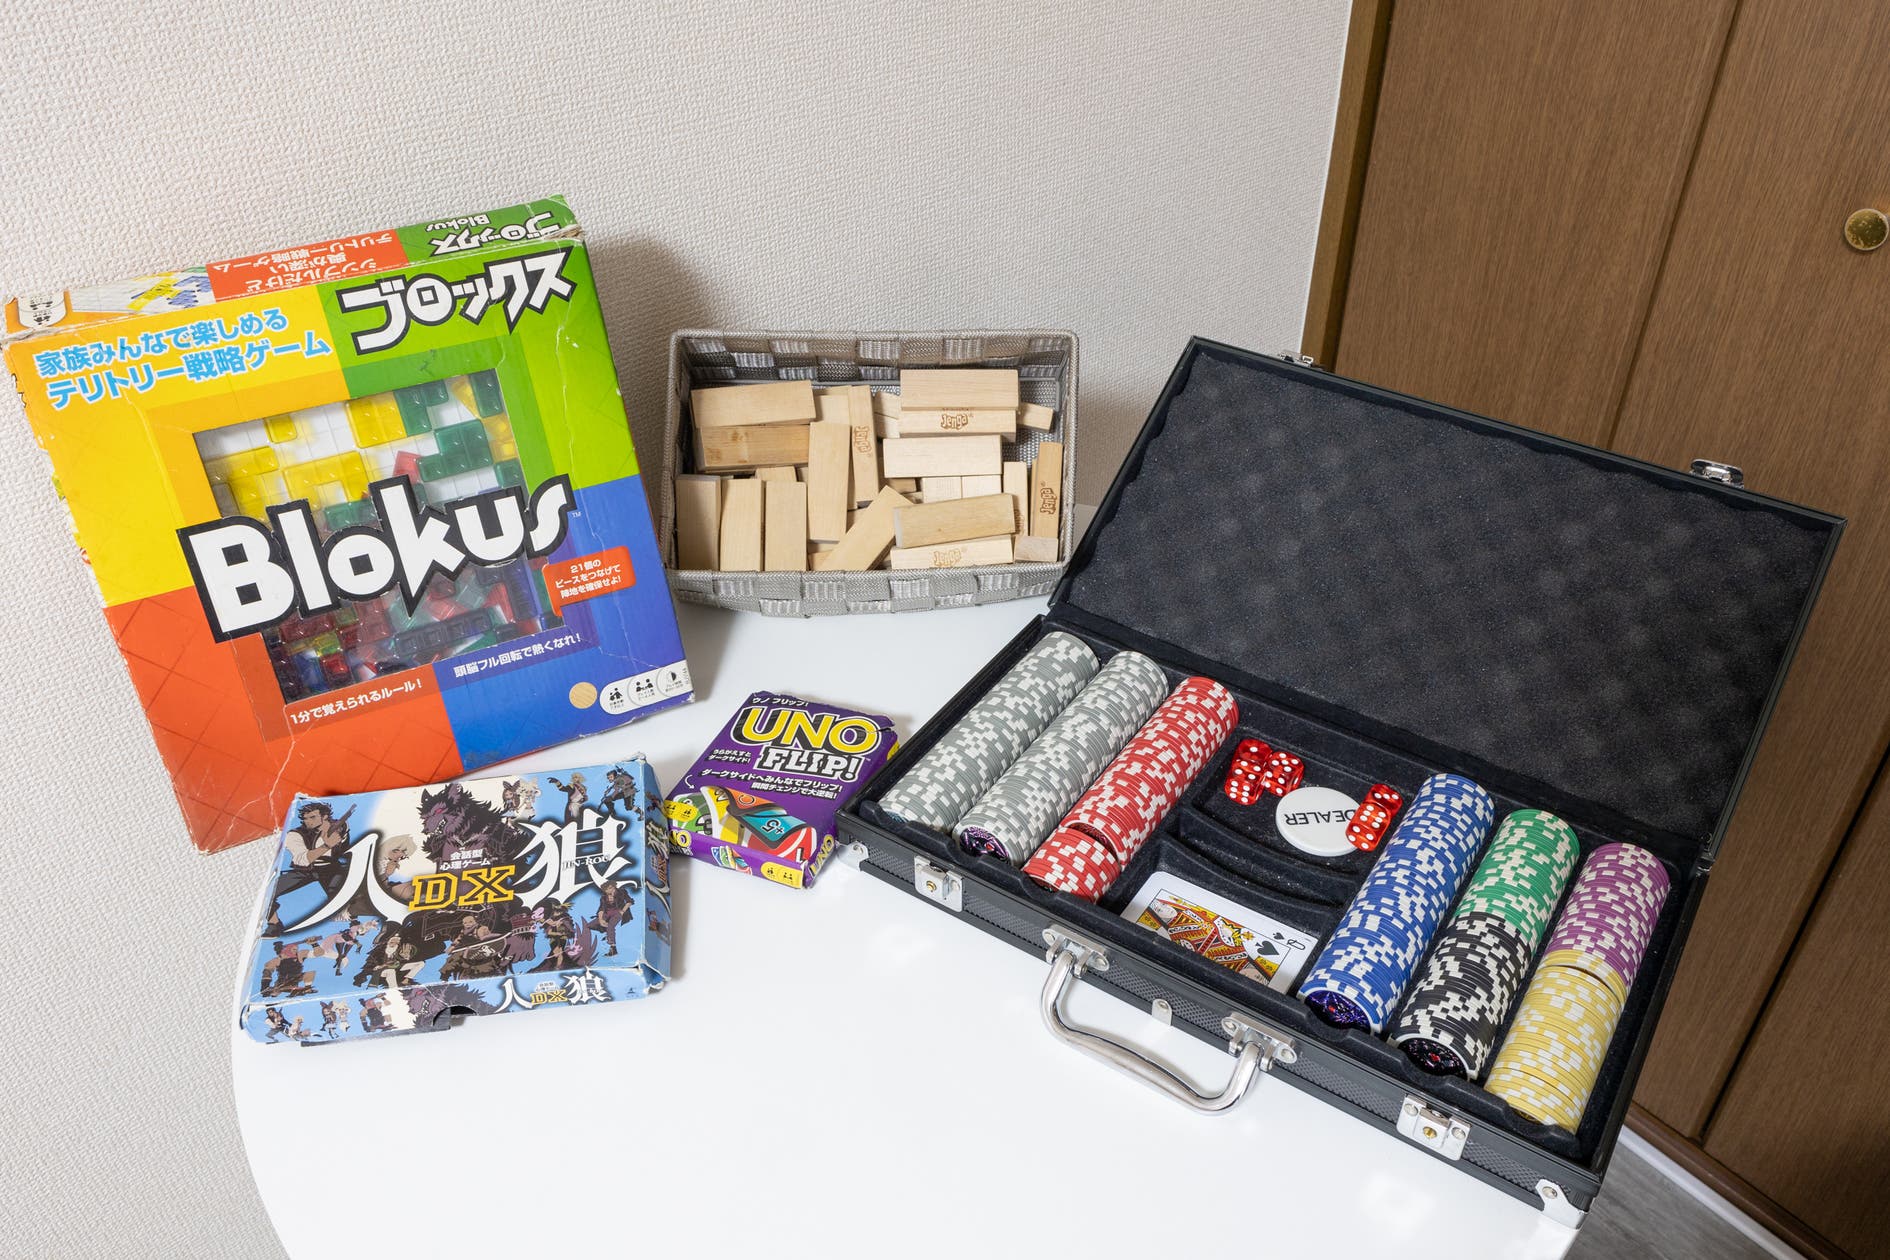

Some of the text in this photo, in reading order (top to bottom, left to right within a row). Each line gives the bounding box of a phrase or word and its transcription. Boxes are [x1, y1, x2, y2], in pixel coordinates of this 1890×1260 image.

[426, 213, 491, 233] Blokus
[430, 210, 561, 257] ブロックス
[212, 232, 393, 273] テリトリー戦略ゲーム
[269, 251, 347, 274] 奥が深い
[244, 257, 378, 293] シンプルだけど
[336, 247, 577, 355] ブロックス
[35, 307, 289, 378] 家族みんなで楽しめる
[46, 330, 333, 410] テリトリー戦略ゲーム
[941, 414, 969, 430] Jenga
[1040, 488, 1058, 514] Jenga
[177, 474, 577, 643] Blokus
[555, 564, 622, 589] ピースをつなげて
[570, 559, 602, 574] 21個の
[454, 633, 583, 678] 頭脳フル回転で熱くなれ!
[290, 678, 423, 725] 1分で覚えられるルール!
[732, 706, 880, 756] UNO
[702, 768, 842, 793] ダークサイドへみんなでフリップ!
[759, 747, 862, 780] FLIP!
[409, 865, 516, 911] DX
[1286, 939, 1306, 951] Q
[530, 989, 568, 1006] DX
